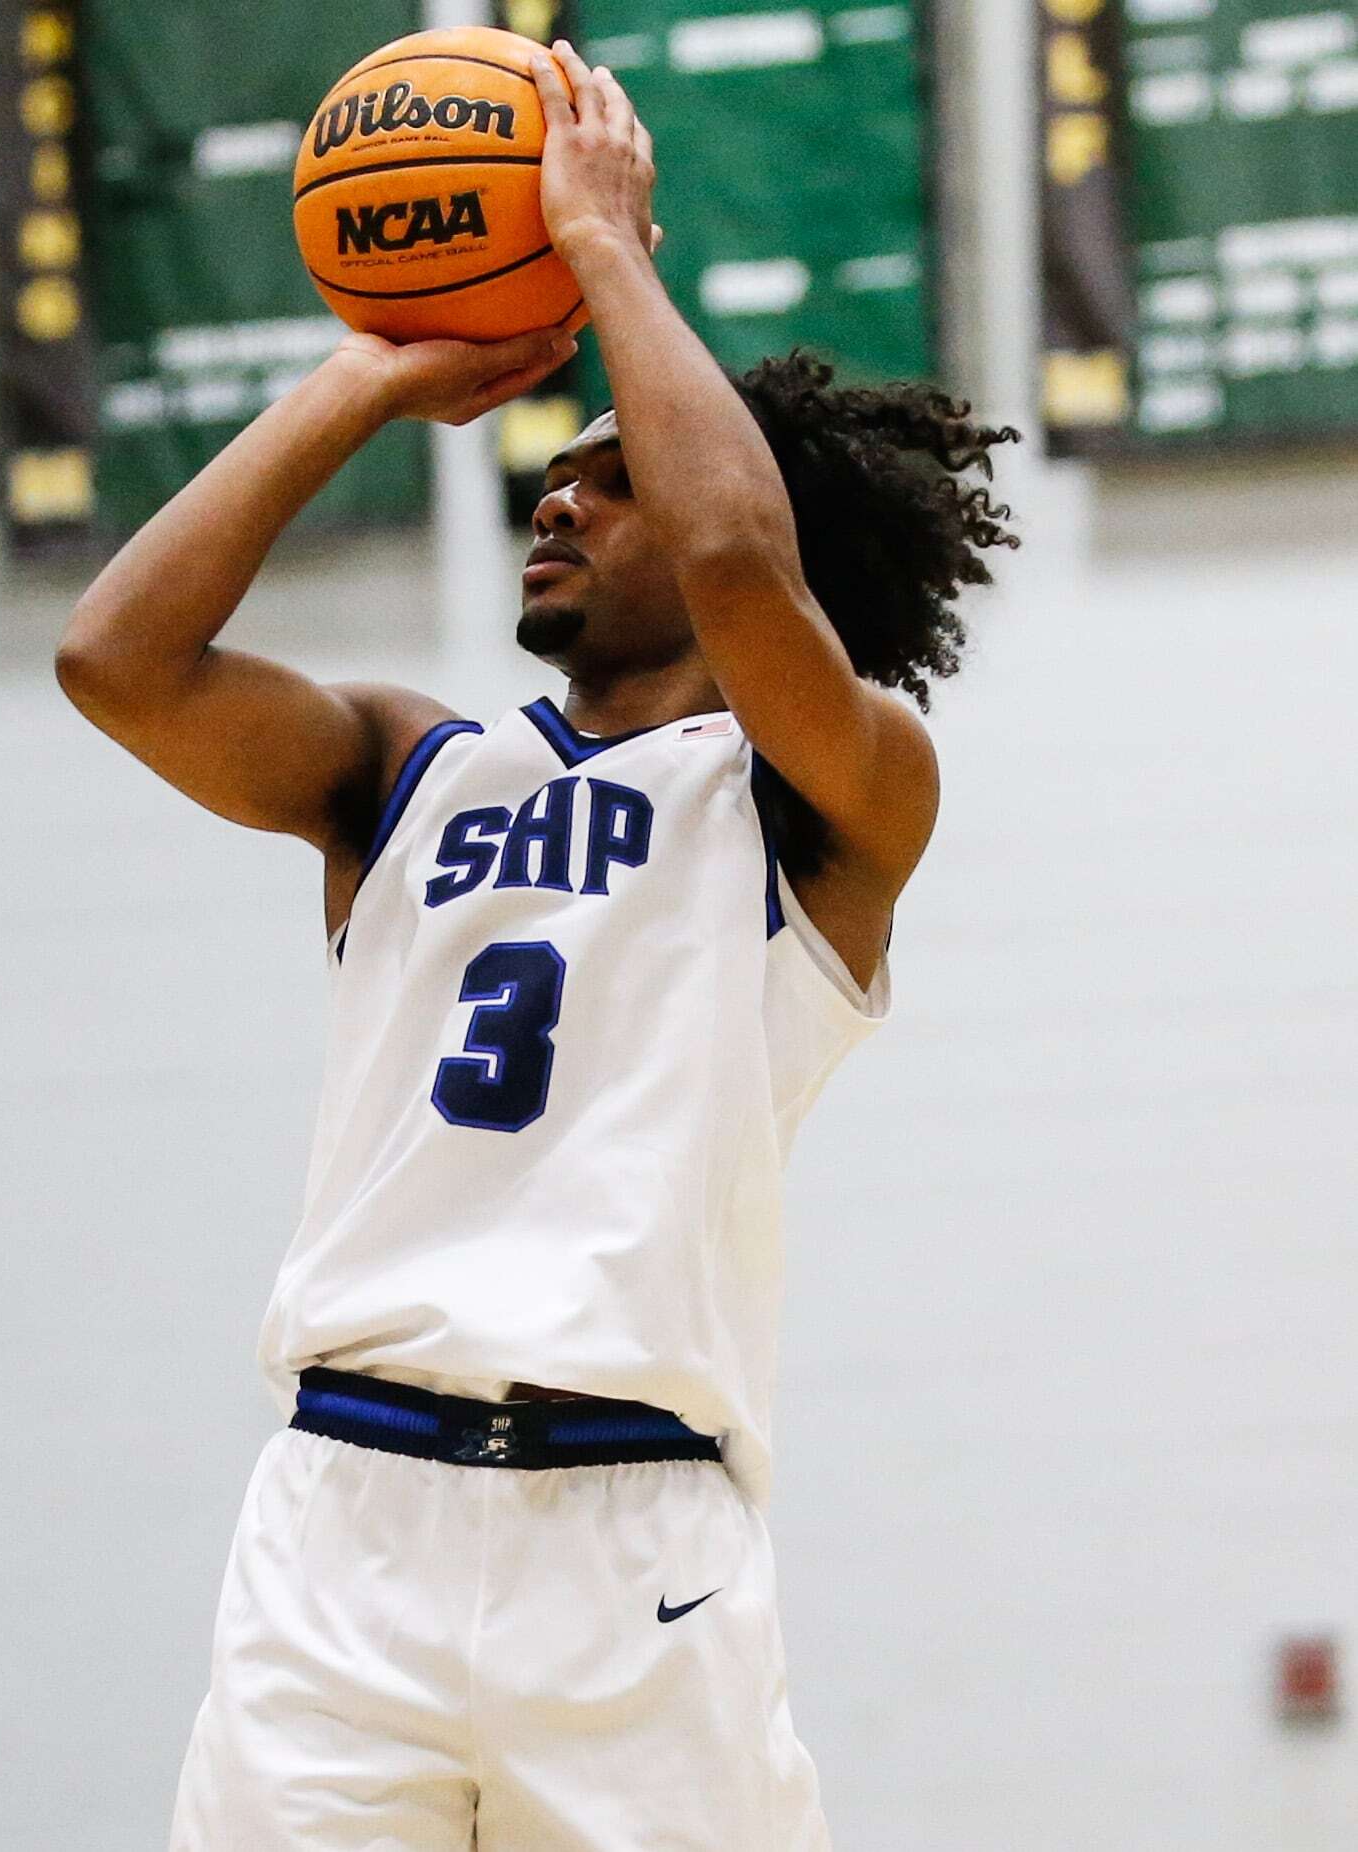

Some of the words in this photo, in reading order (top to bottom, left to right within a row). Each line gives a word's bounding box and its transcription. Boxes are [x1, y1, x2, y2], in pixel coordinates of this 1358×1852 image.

[314, 81, 515, 158] Wilson
[336, 191, 488, 255] NCAA
[339, 258, 393, 269] OFFICIAL
[397, 251, 439, 264] GAME
[424, 776, 654, 908] SHP
[430, 940, 567, 1133] 3
[491, 1418, 511, 1432] SHP
